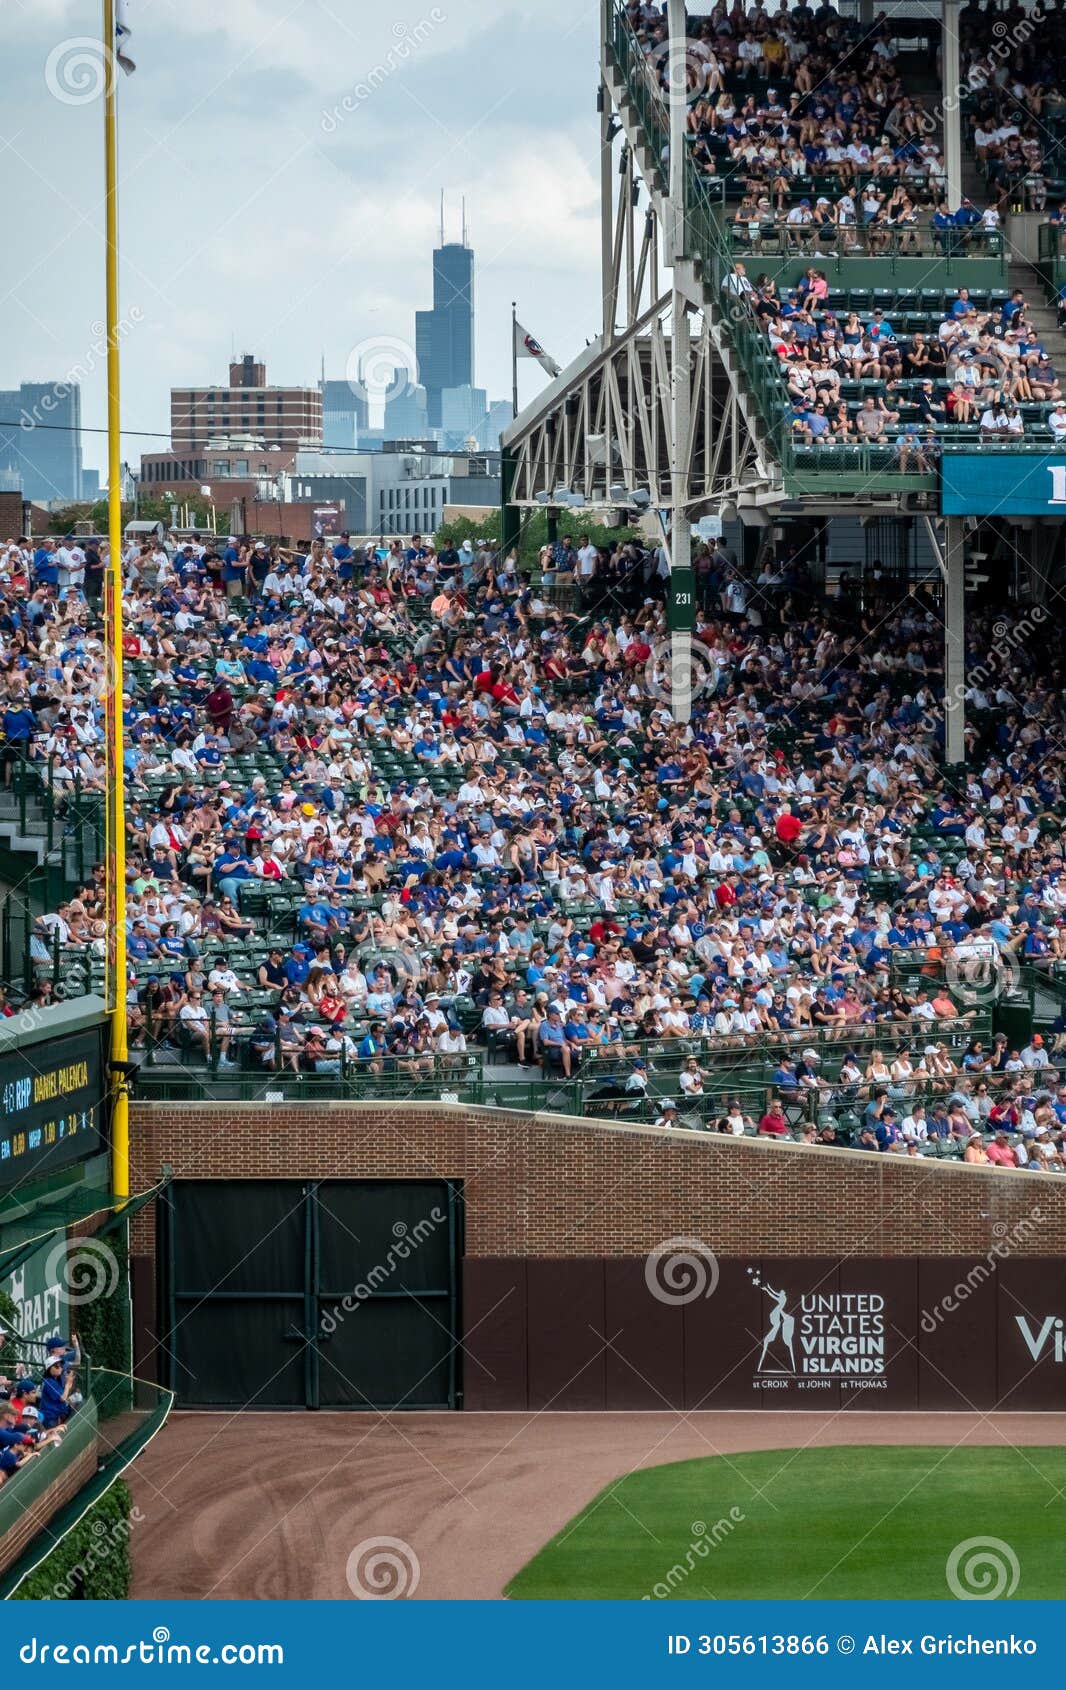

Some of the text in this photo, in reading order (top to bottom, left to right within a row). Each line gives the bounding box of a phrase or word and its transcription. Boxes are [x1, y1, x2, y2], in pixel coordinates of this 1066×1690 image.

[675, 593, 691, 605] 231
[16, 1077, 31, 1110] RHP
[34, 1072, 57, 1103] DANIEL
[59, 1061, 88, 1095] PALENCIA
[1, 1140, 11, 1160] ERA
[801, 1294, 885, 1313] UNITED
[800, 1315, 884, 1334] STATES
[800, 1336, 884, 1355] VIRGIN
[1015, 1316, 1066, 1362] Vi
[803, 1358, 885, 1373] ISLANDS
[761, 1380, 789, 1389] CROIX
[806, 1380, 831, 1389] JOHN
[850, 1380, 888, 1389] THOMAS
